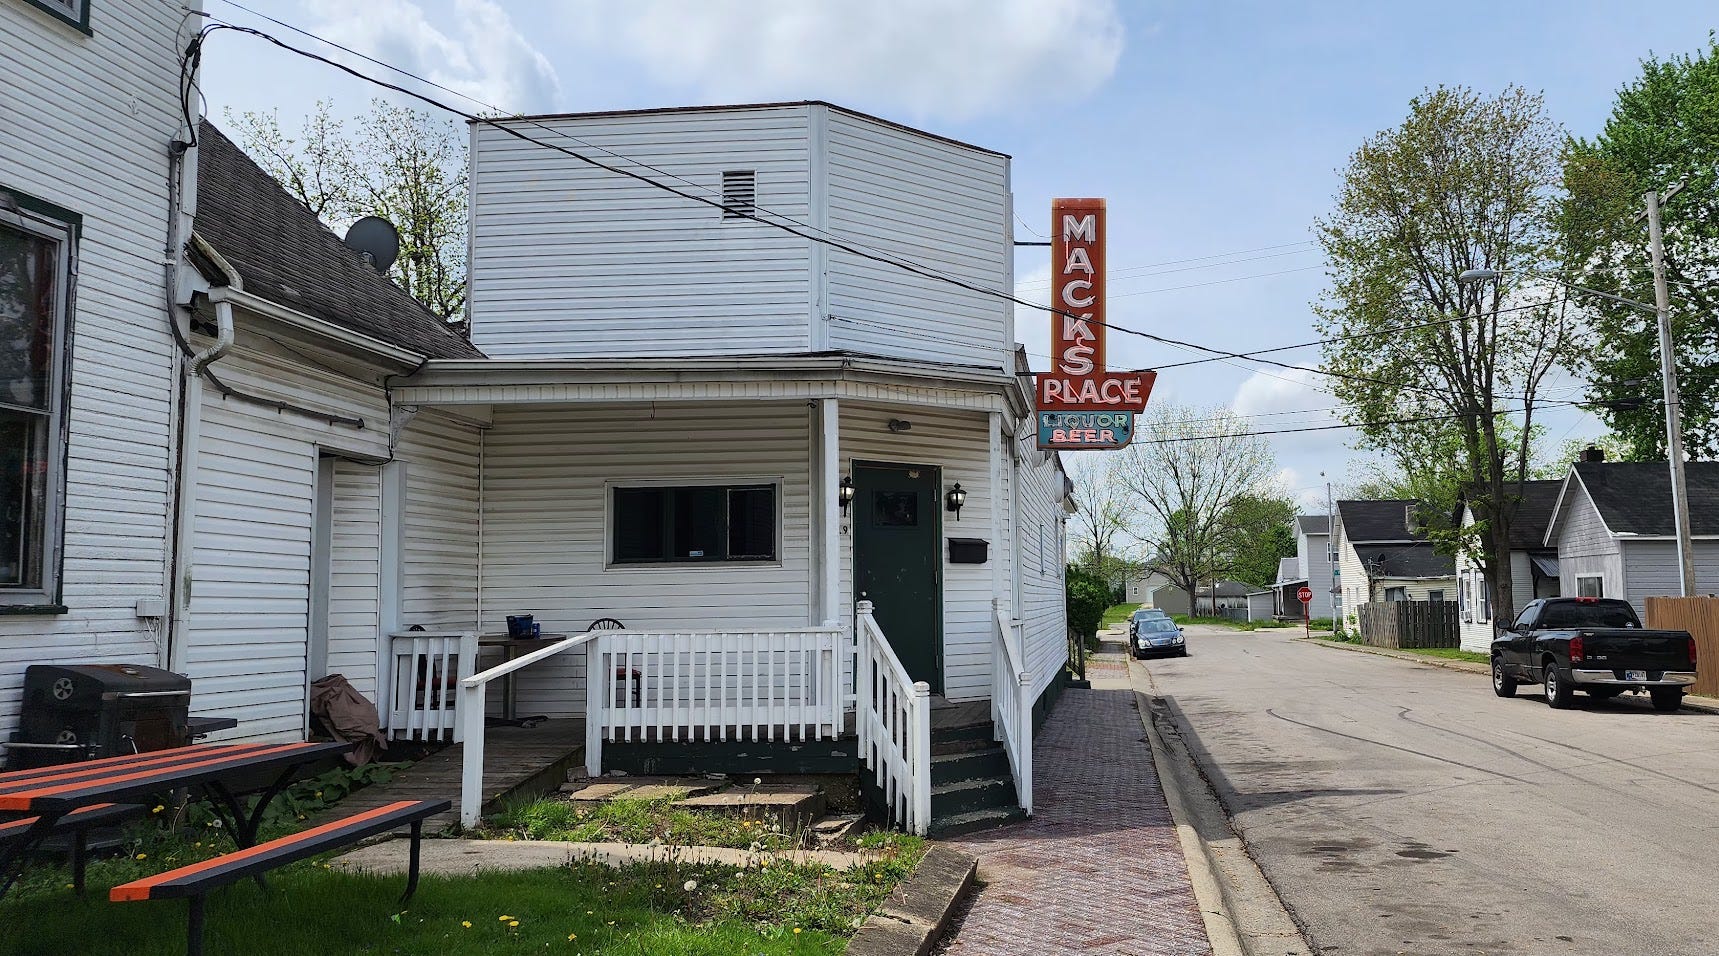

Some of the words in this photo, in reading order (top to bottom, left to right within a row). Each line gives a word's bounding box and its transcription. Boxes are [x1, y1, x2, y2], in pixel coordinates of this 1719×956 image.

[1061, 214, 1096, 376] MACKS
[1043, 377, 1142, 405] PLACE
[1043, 414, 1127, 429] LIQUOR
[1050, 429, 1116, 443] BEER
